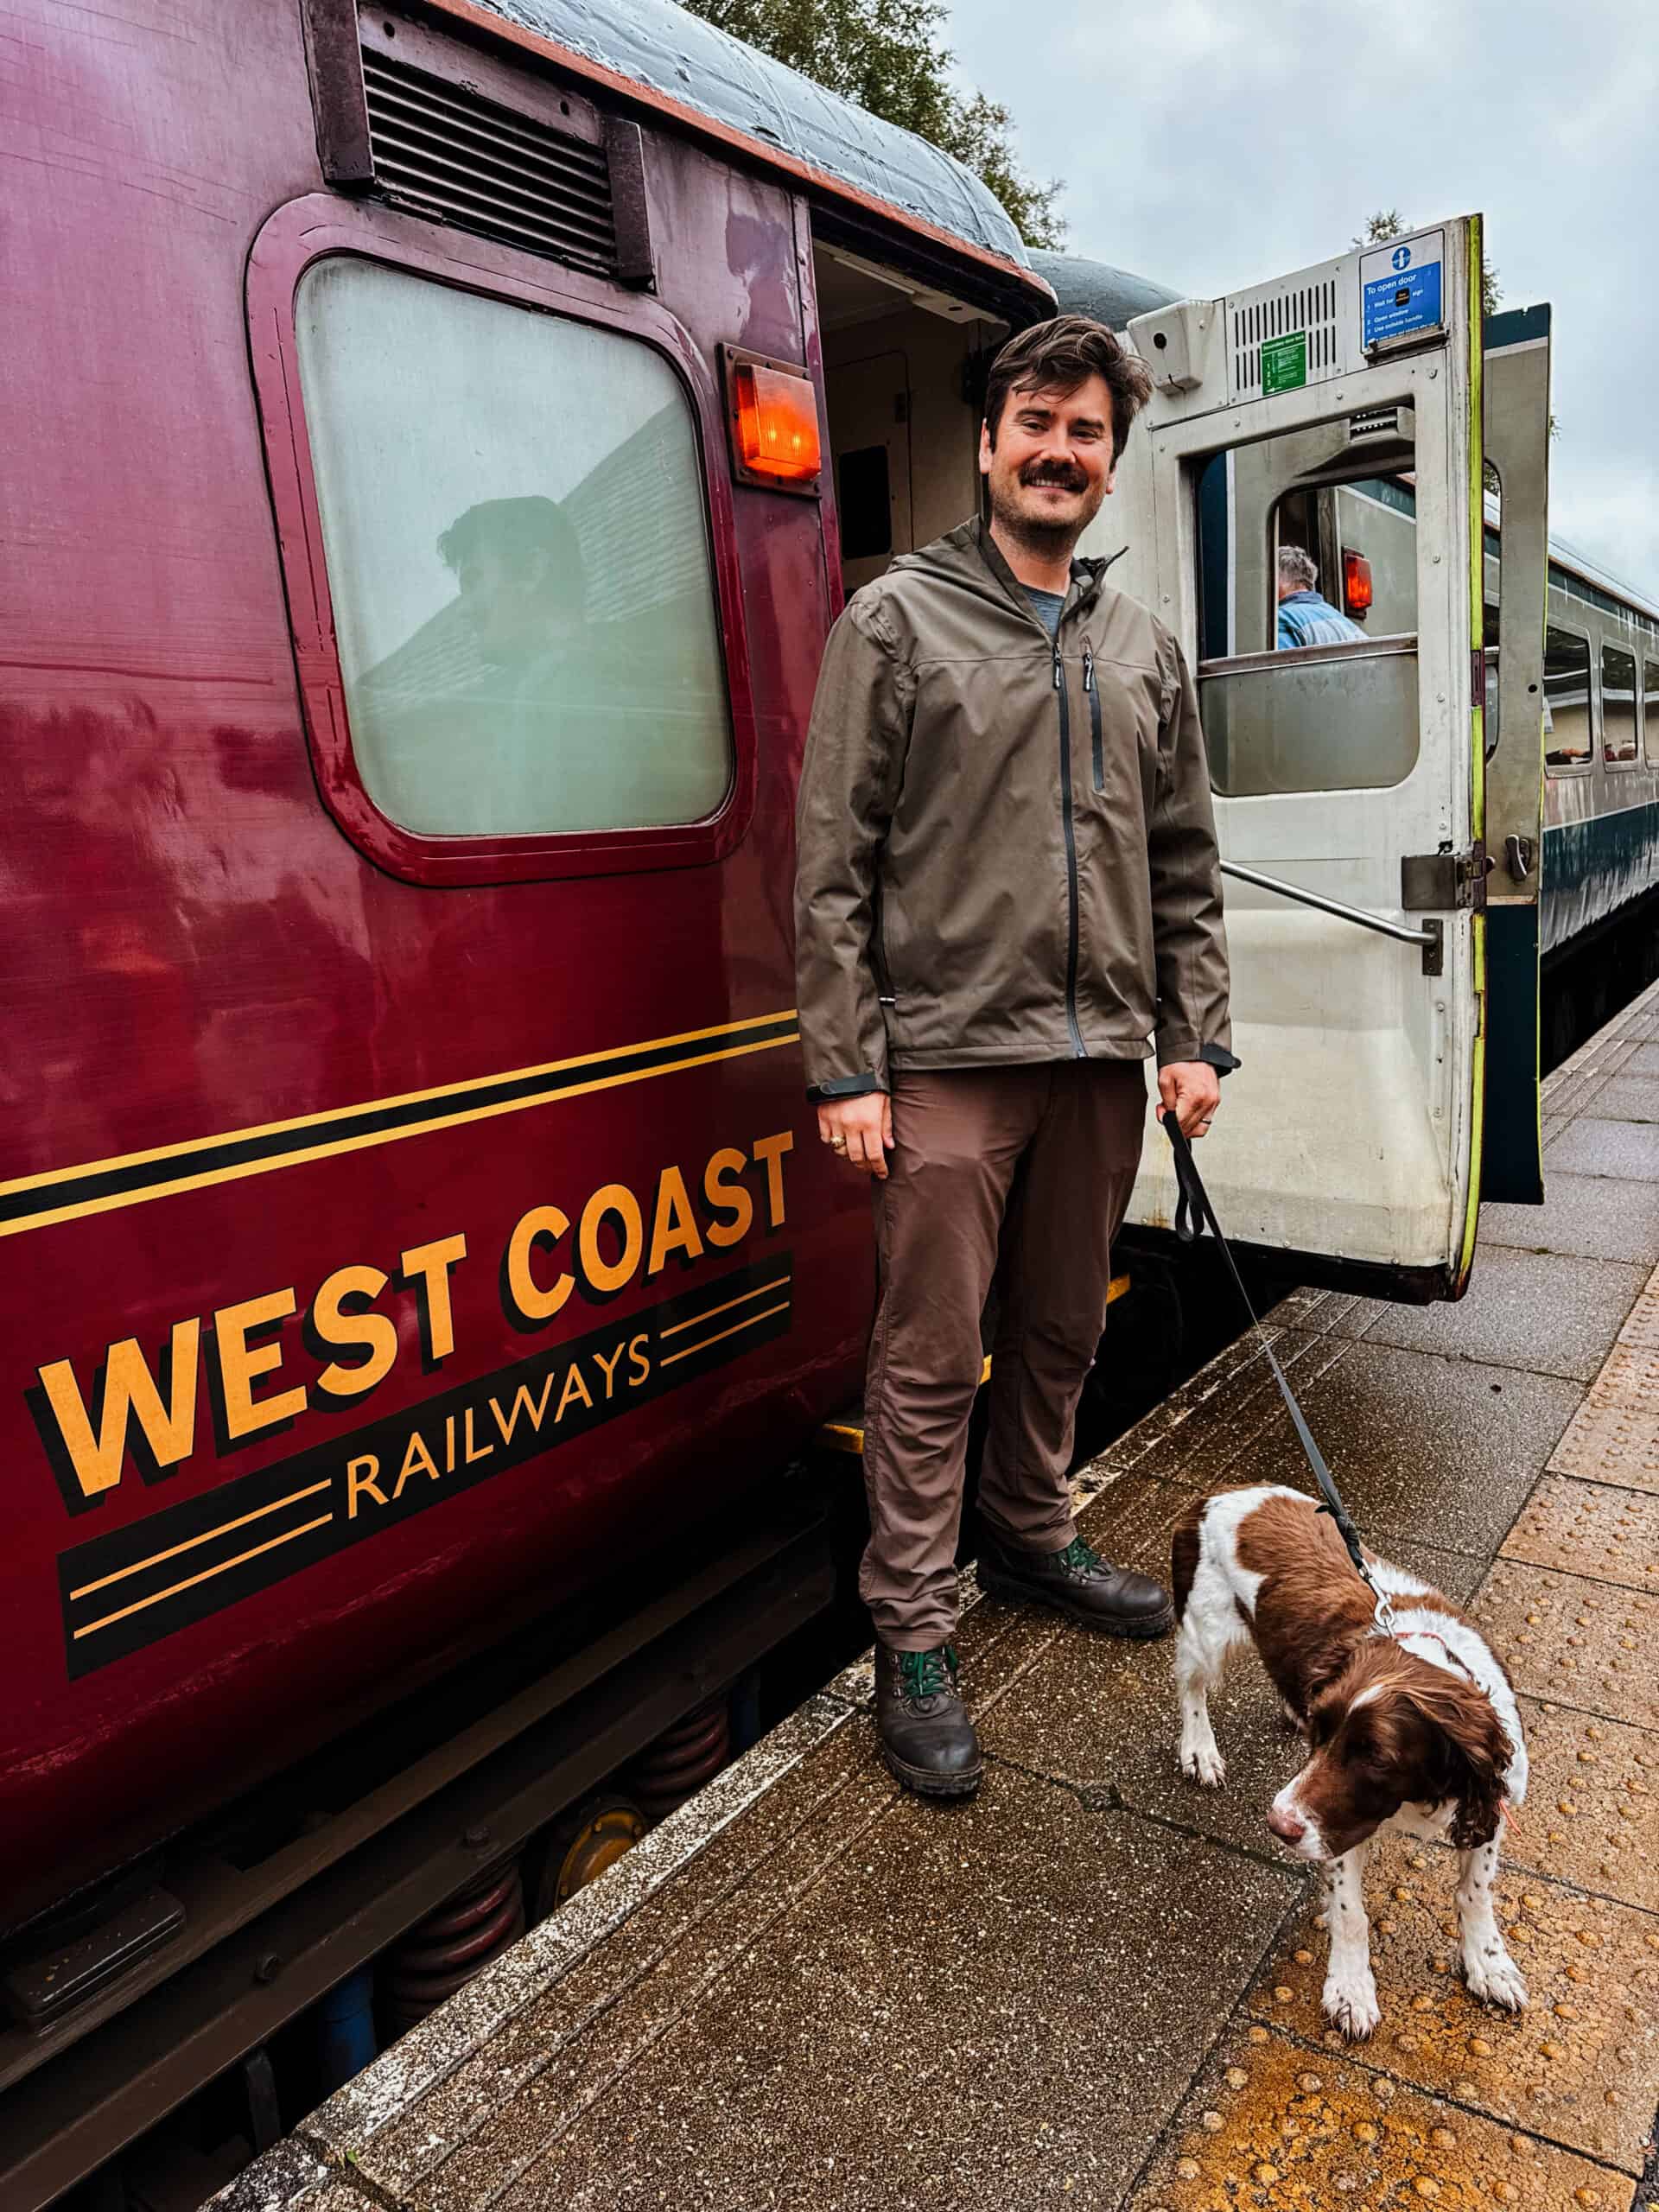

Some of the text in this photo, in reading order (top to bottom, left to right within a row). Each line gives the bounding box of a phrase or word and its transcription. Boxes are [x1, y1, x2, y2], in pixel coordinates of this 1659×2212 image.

[1367, 274, 1417, 296] To open door
[37, 1130, 794, 1498] WEST COAST
[347, 1333, 650, 1518] RAILWAYS
